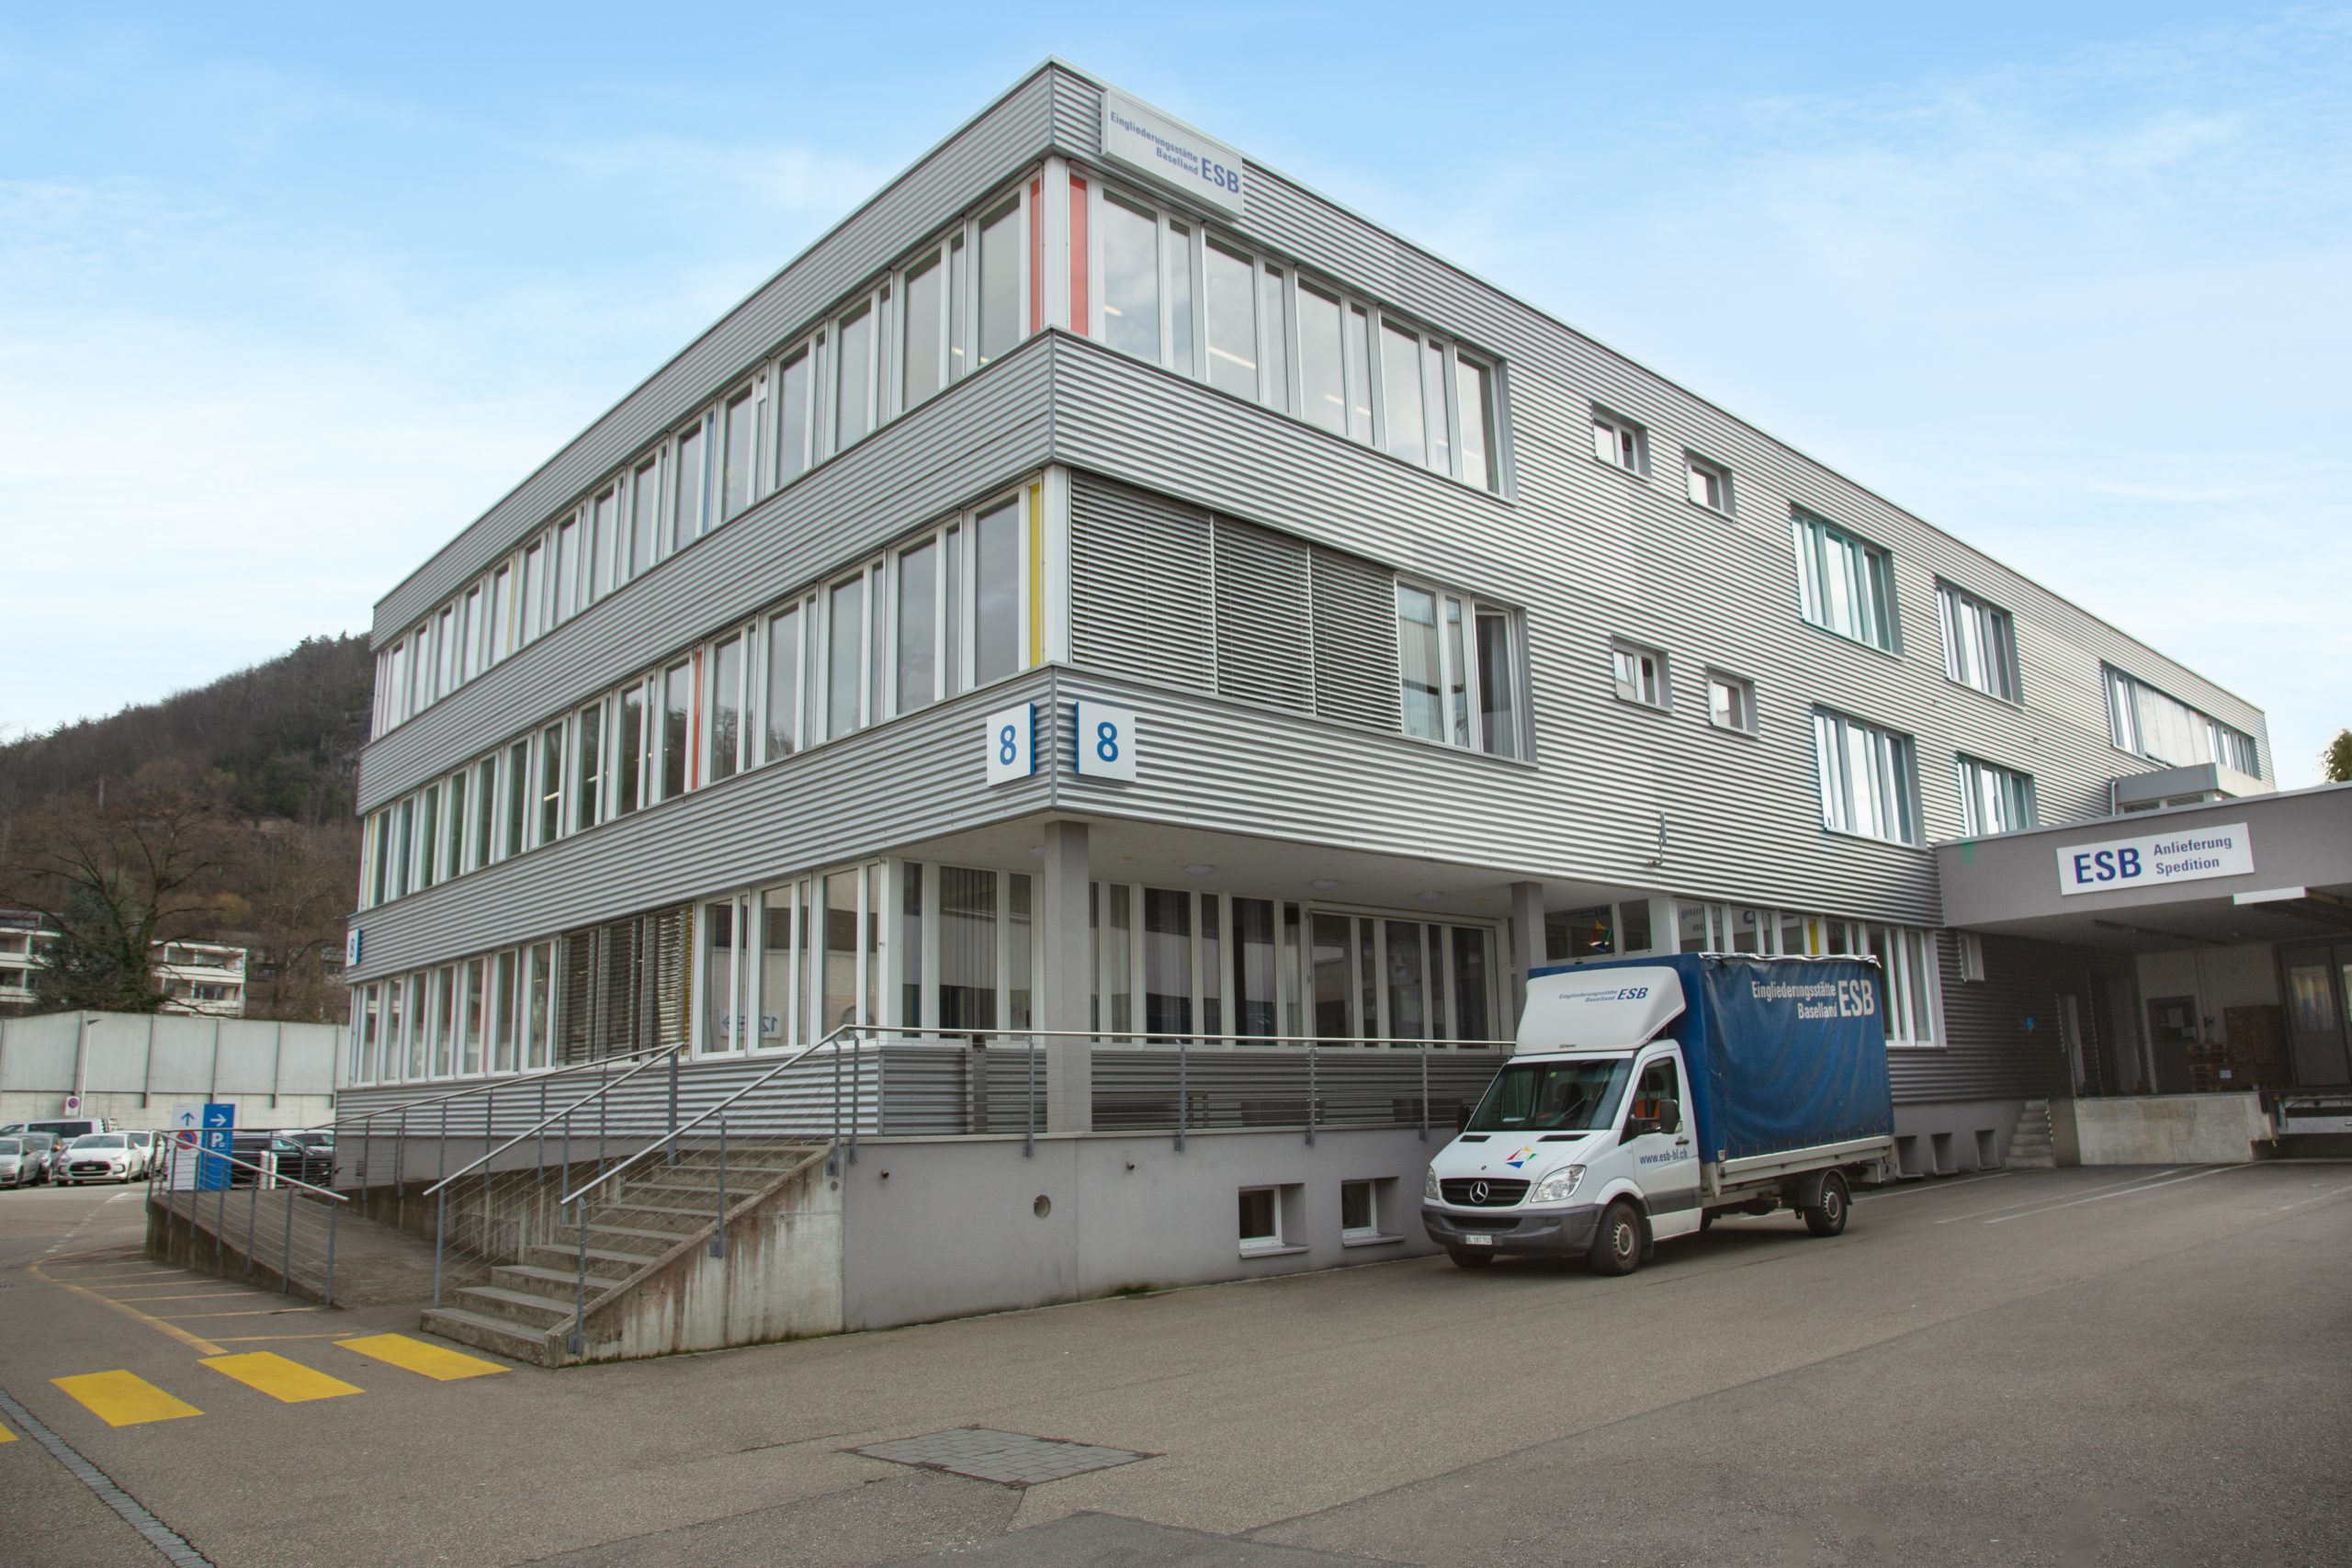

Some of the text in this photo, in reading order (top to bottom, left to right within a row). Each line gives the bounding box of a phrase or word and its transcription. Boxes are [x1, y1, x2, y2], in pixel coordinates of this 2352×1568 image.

[1111, 111, 1198, 163] Eingliederungsstätte
[1156, 147, 1198, 175] Baselland
[1201, 157, 1239, 194] ESB
[999, 724, 1017, 765] 8
[1096, 721, 1119, 762] 8
[2153, 837, 2233, 856] Anlieferung
[2073, 847, 2143, 885] ESB
[2155, 857, 2220, 876] Spedition
[1617, 987, 1648, 1000] ESB
[1751, 981, 1837, 1002] Eingliederungsstätte
[1838, 979, 1875, 1017] ESB
[1797, 1000, 1838, 1020] Baselland
[1639, 1148, 1688, 1165] www.esb-bl.ch
